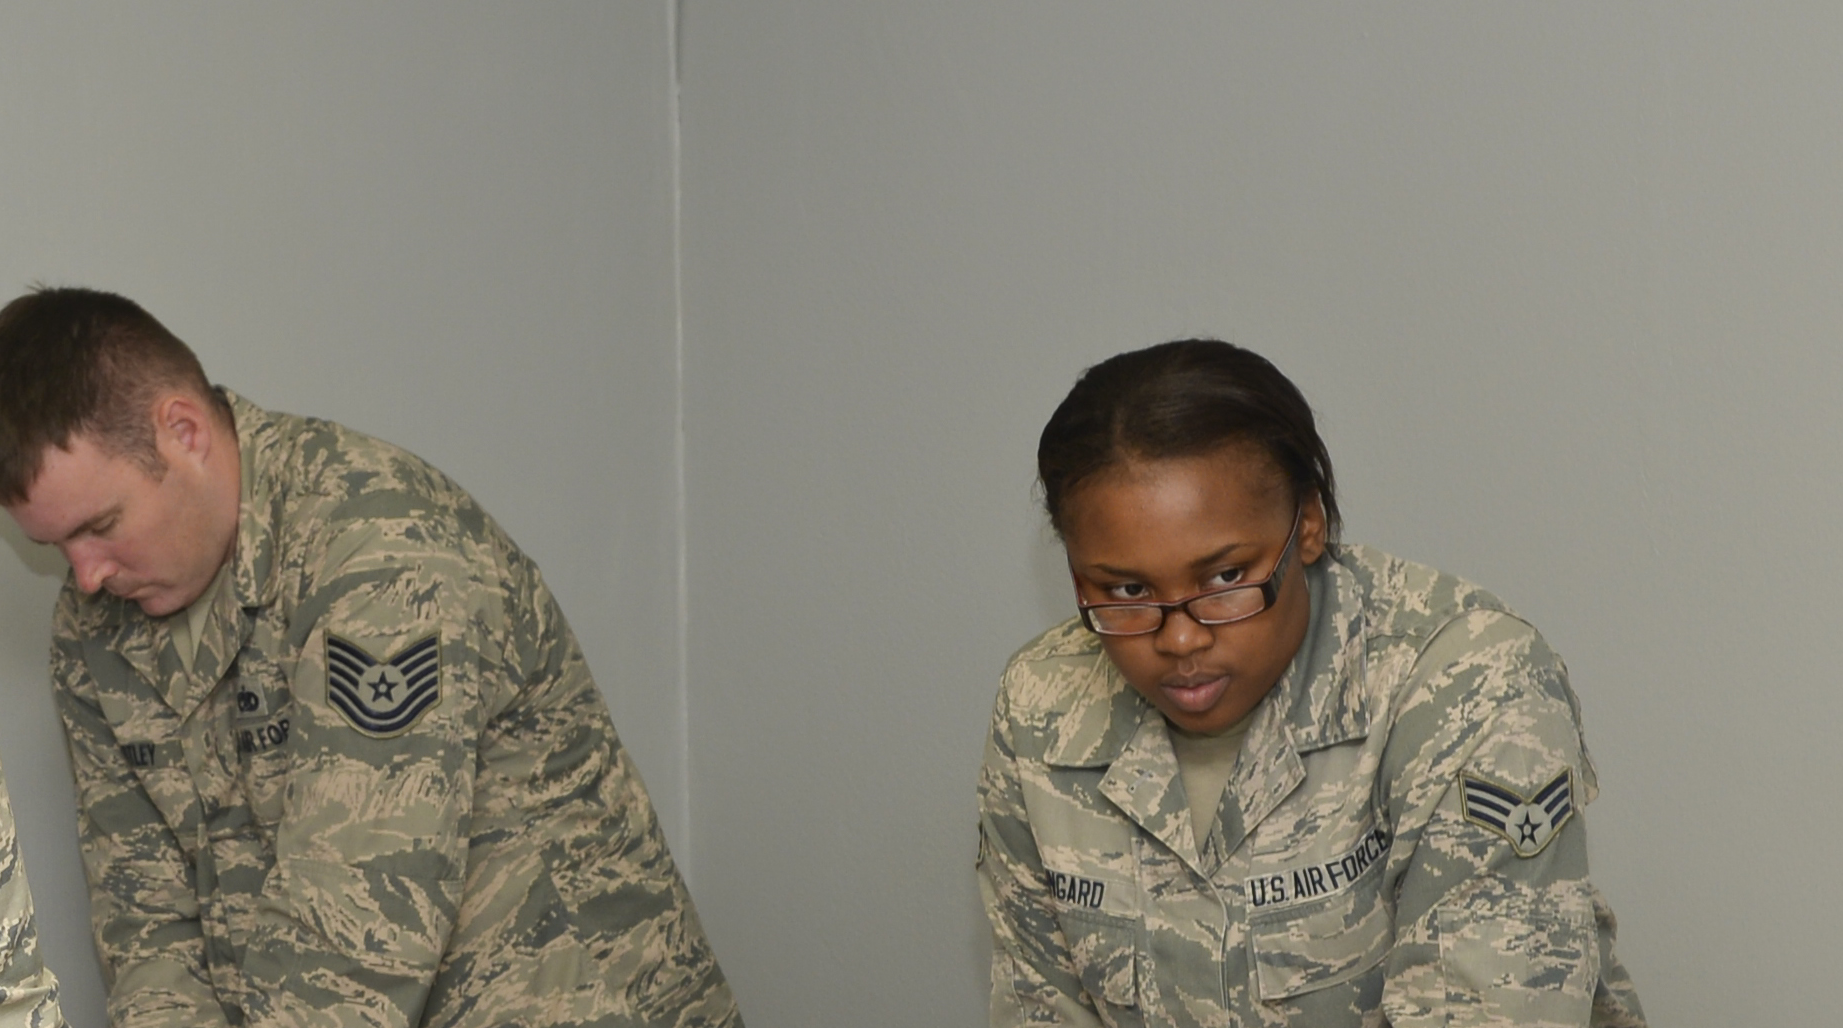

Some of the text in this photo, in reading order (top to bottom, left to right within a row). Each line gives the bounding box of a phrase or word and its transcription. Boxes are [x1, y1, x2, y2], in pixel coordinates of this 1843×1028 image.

[1045, 869, 1105, 909] NGARD
[1250, 828, 1389, 907] U.S. AIR FORCE
